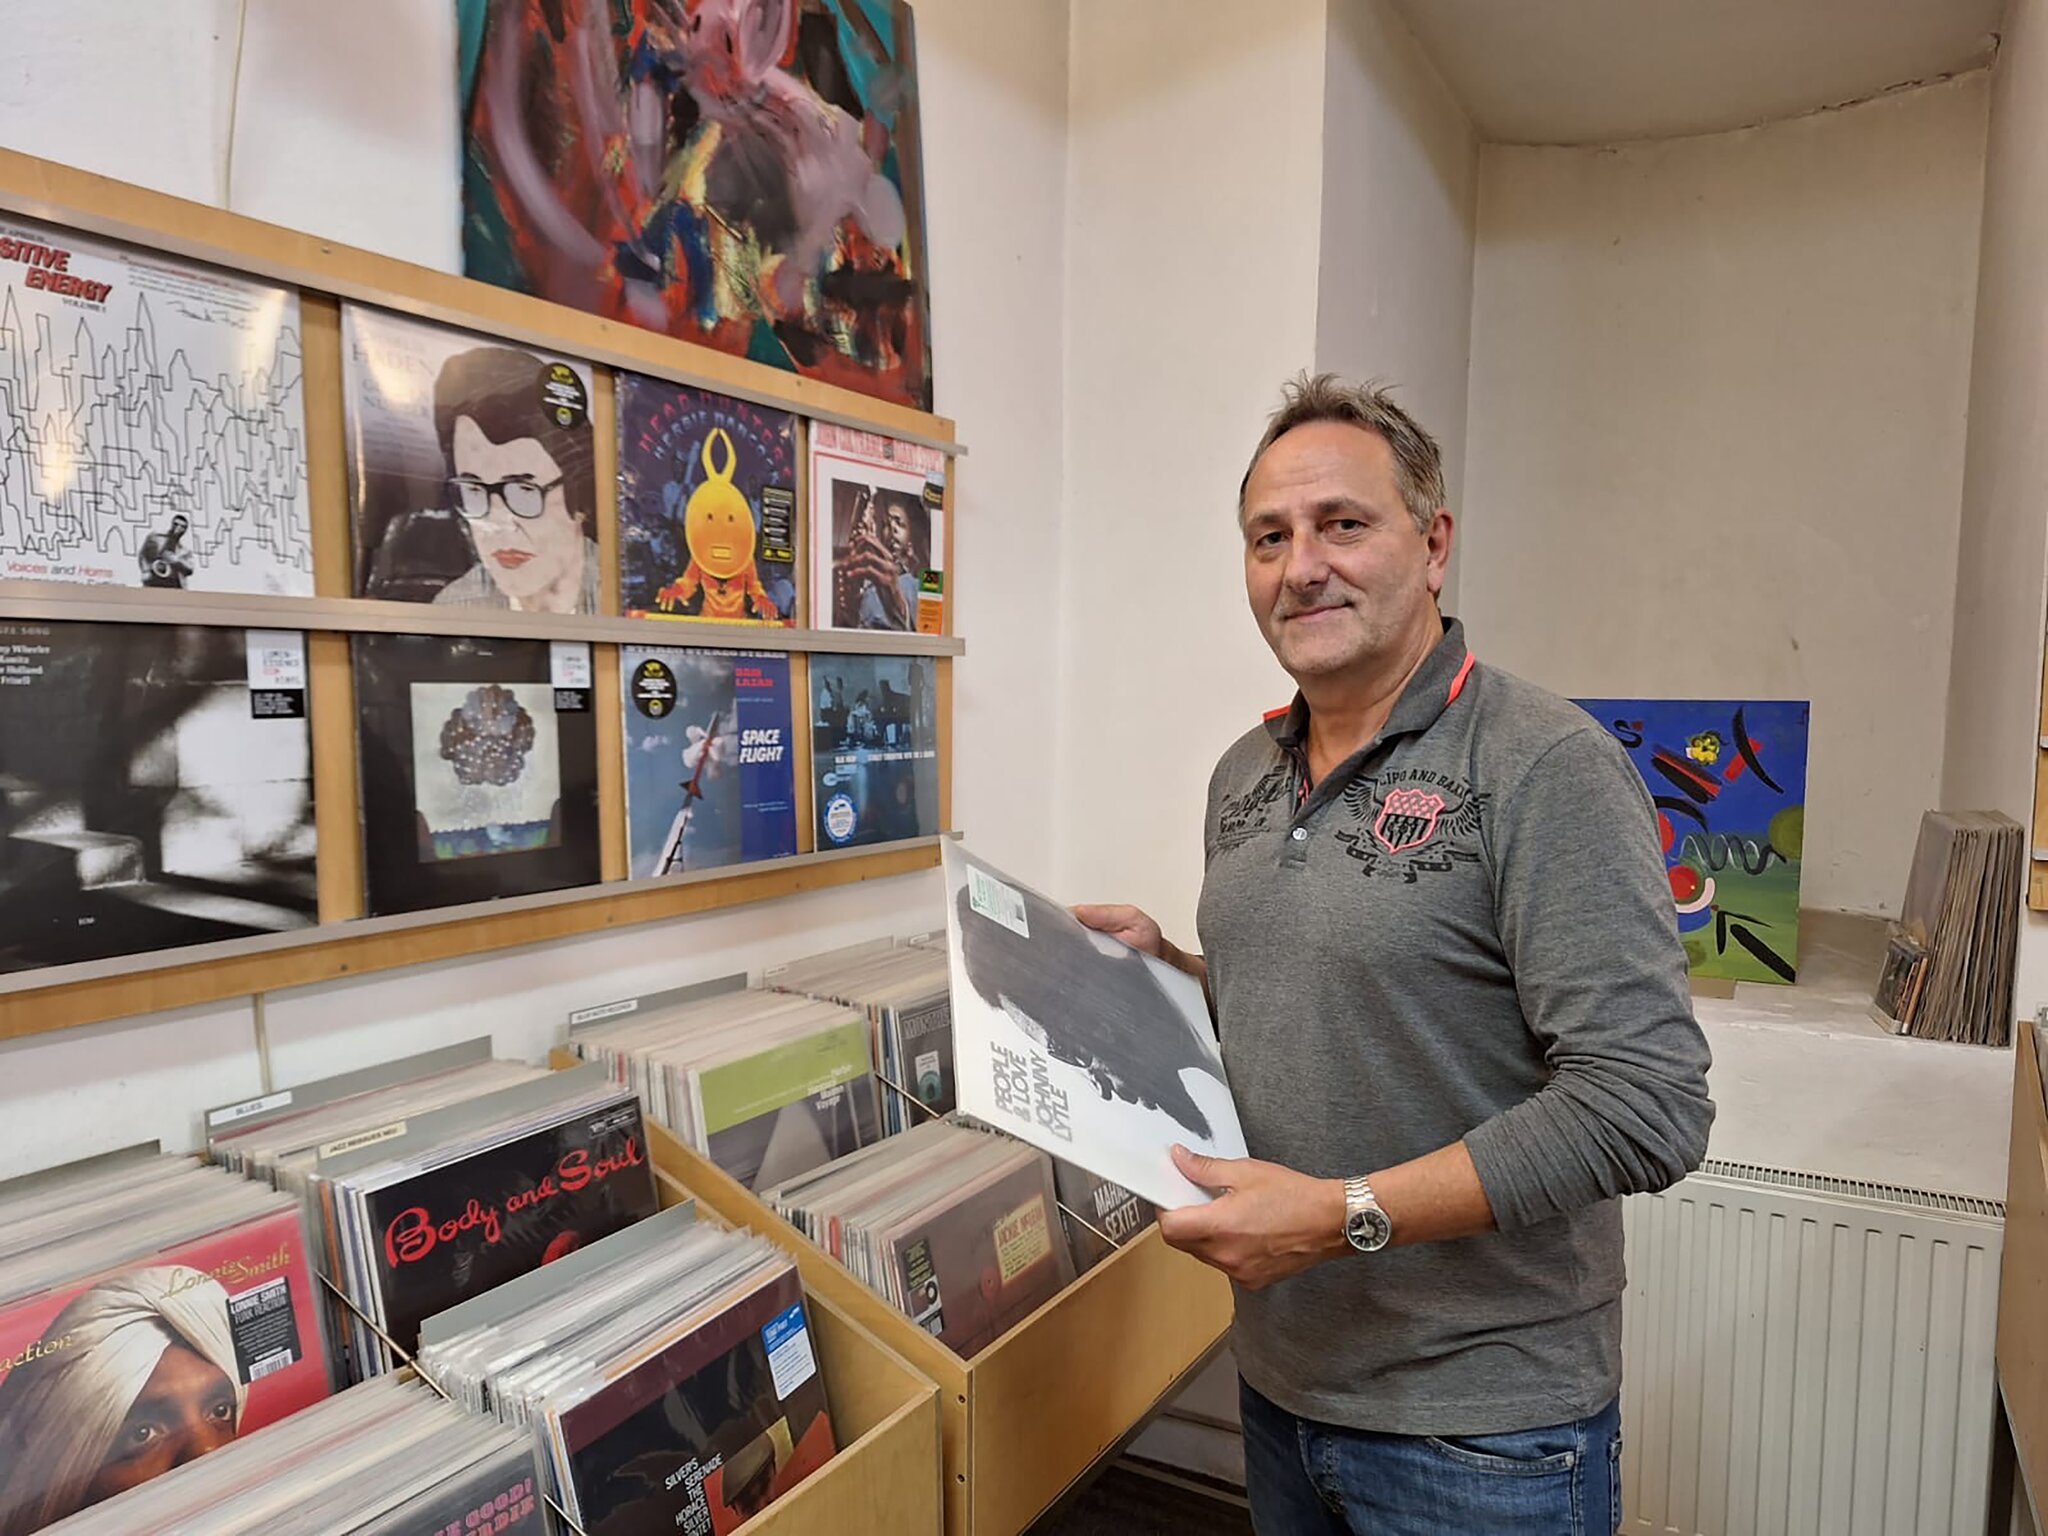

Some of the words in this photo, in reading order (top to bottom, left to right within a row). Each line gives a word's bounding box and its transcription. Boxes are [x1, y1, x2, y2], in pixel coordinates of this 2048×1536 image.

[25, 266, 113, 304] ENERGY
[7, 561, 48, 574] Voices
[51, 565, 76, 576] and
[739, 745, 784, 764] FLIGHT
[740, 729, 781, 746] SPACE
[1408, 768, 1438, 783] AND
[990, 1041, 1013, 1115] PEOPLE
[1009, 1050, 1031, 1105] LOVE
[1030, 1048, 1057, 1135] JOHNNY
[1050, 1084, 1072, 1142] LYTLE
[384, 1199, 501, 1269] Body
[506, 1176, 559, 1213] and
[558, 1136, 645, 1191] Soul
[1105, 1196, 1141, 1240] SEXTET
[160, 1259, 238, 1300] Lonnie
[228, 1241, 291, 1285] Smith
[230, 1294, 259, 1315] LONNIE
[260, 1283, 287, 1302] SMITH
[234, 1308, 254, 1325] FUNK
[684, 1452, 725, 1490] SERENADE
[688, 1482, 704, 1501] THE
[675, 1494, 707, 1526] HORACE
[683, 1506, 709, 1534] SILVER
